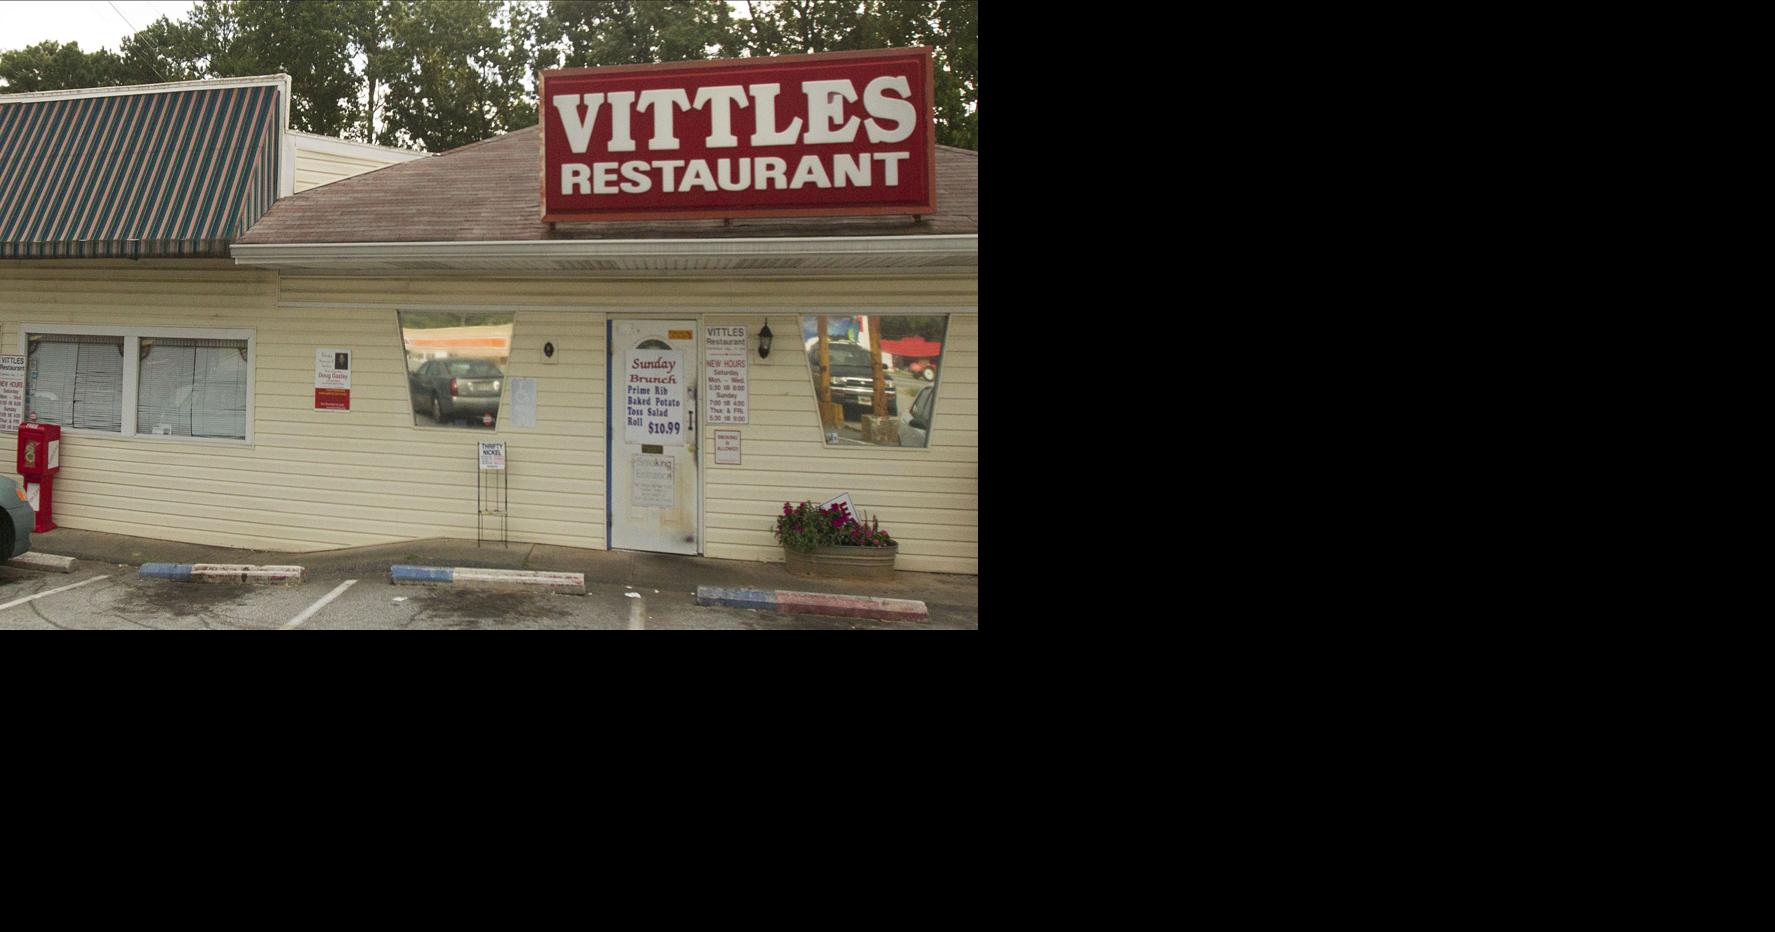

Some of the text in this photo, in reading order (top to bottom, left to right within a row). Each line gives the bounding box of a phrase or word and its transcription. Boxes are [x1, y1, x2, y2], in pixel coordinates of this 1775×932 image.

[553, 75, 917, 153] VITTLES
[561, 151, 910, 195] RESTAURANT
[707, 328, 745, 337] VITTLES
[706, 338, 745, 346] Restaurant
[2, 357, 25, 365] VITTLES
[632, 356, 676, 374] Sunday
[705, 360, 746, 368] NEW HOURS
[713, 369, 739, 377] Saturday
[629, 374, 677, 384] Brunch
[627, 385, 668, 395] Prime Rib
[716, 391, 737, 399] Sunday
[627, 396, 680, 407] Baked Potato
[627, 407, 668, 417] Toss Salad
[627, 417, 643, 427] Roll
[648, 421, 680, 435] $10.99
